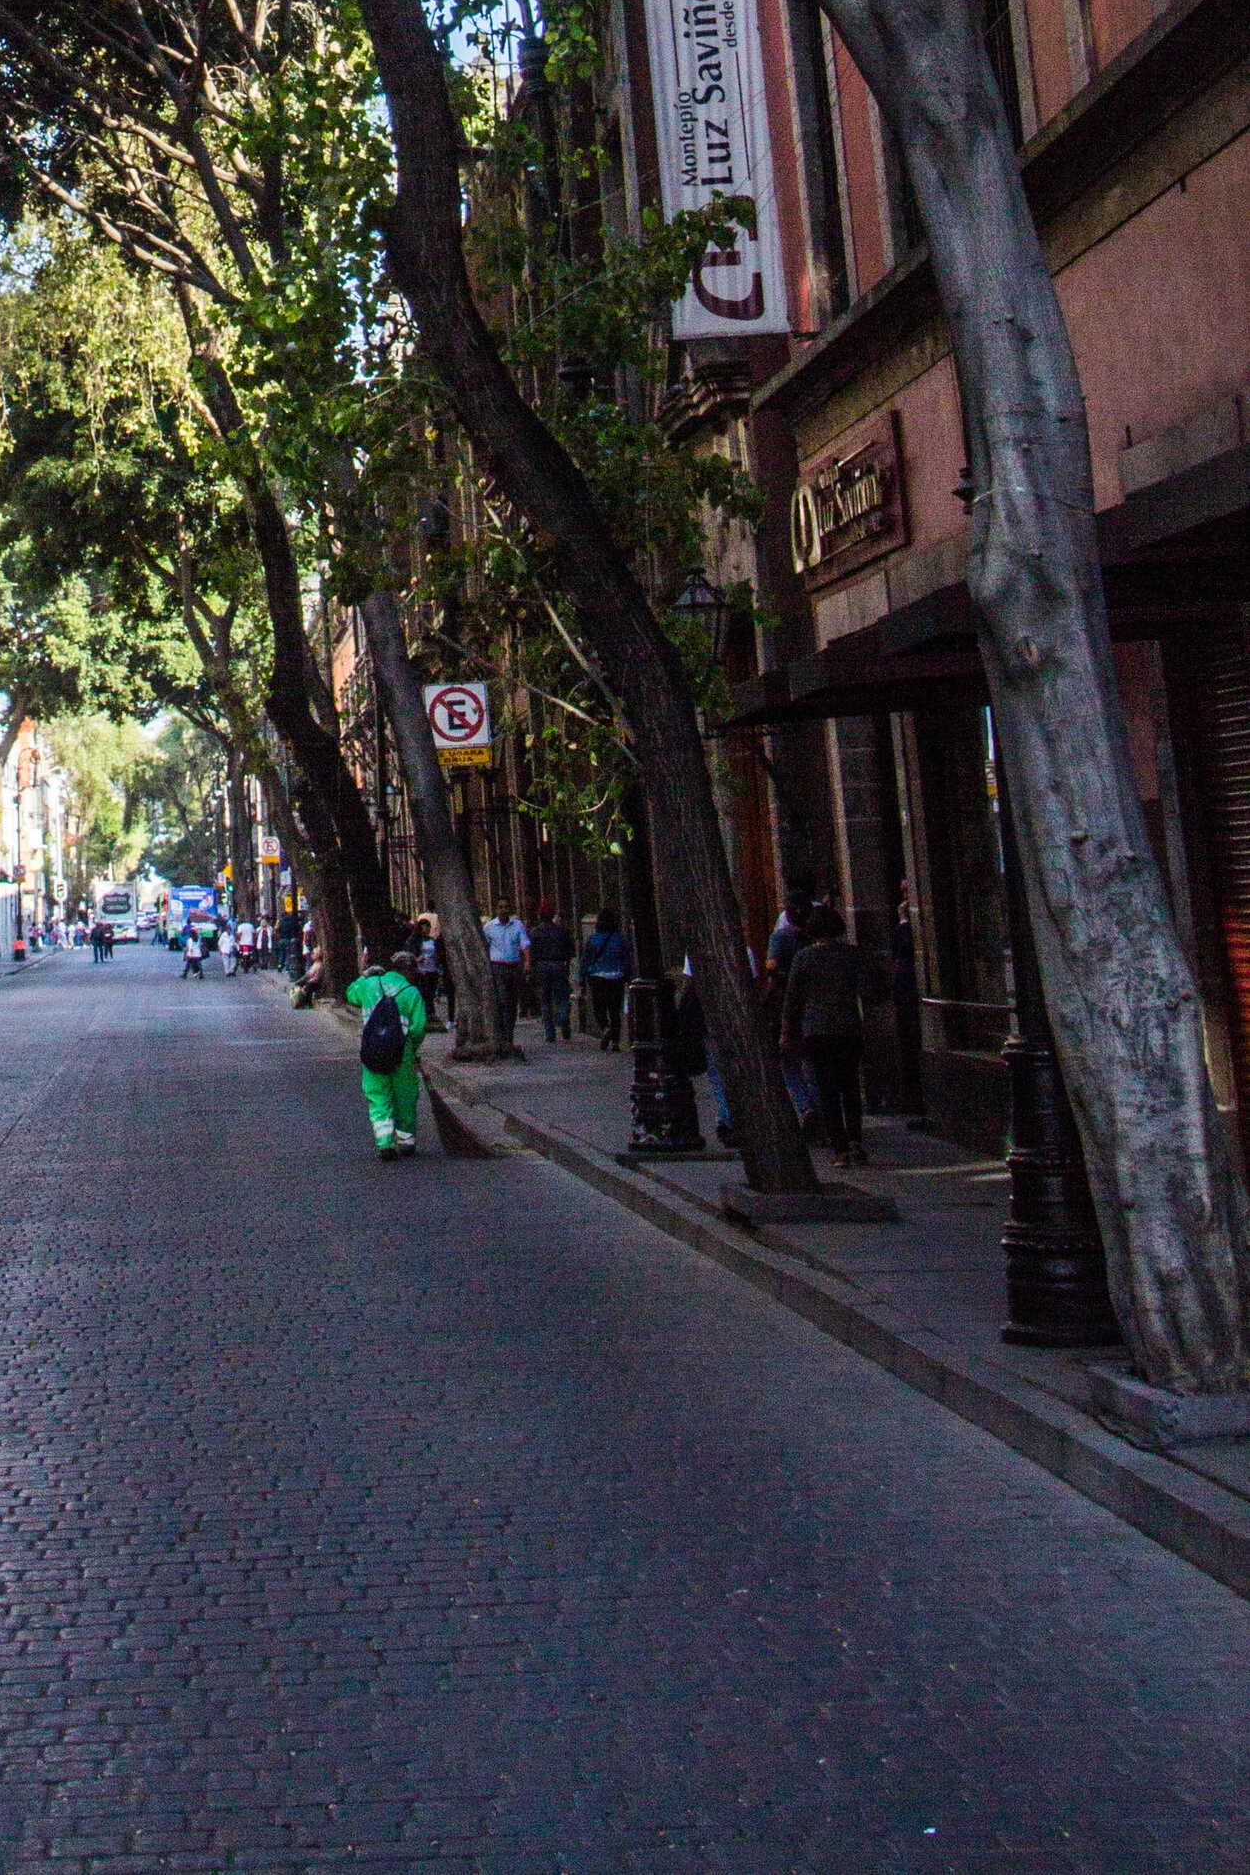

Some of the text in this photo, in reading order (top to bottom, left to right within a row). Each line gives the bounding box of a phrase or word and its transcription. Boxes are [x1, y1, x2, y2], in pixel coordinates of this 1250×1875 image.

[718, 0, 738, 48] desde
[673, 91, 699, 187] Montepío
[701, 118, 734, 186] Luz
[447, 699, 468, 730] E
